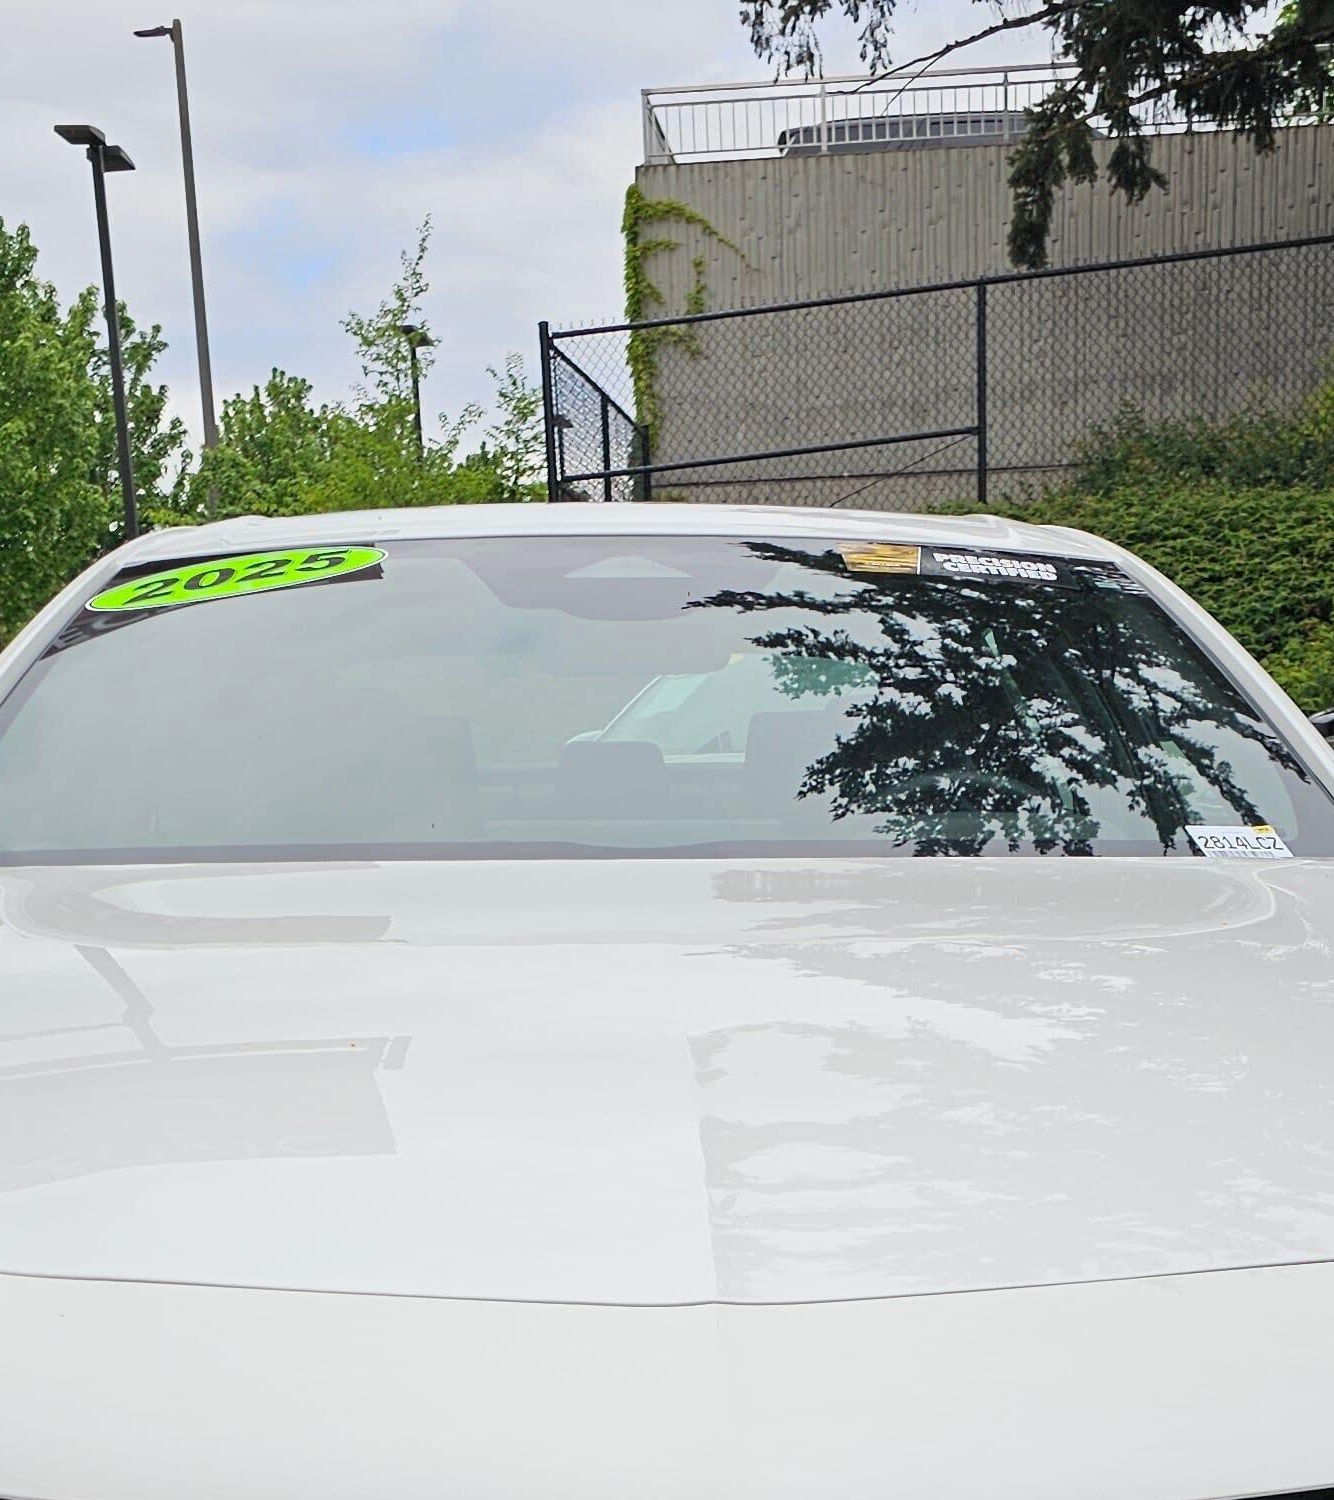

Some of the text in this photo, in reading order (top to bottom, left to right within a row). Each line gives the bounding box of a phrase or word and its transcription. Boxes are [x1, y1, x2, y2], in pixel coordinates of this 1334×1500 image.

[932, 552, 1057, 573] PRECISION
[942, 561, 1058, 581] CERTIFIED
[123, 549, 353, 605] 2025
[1197, 835, 1284, 851] 2814LCZ
